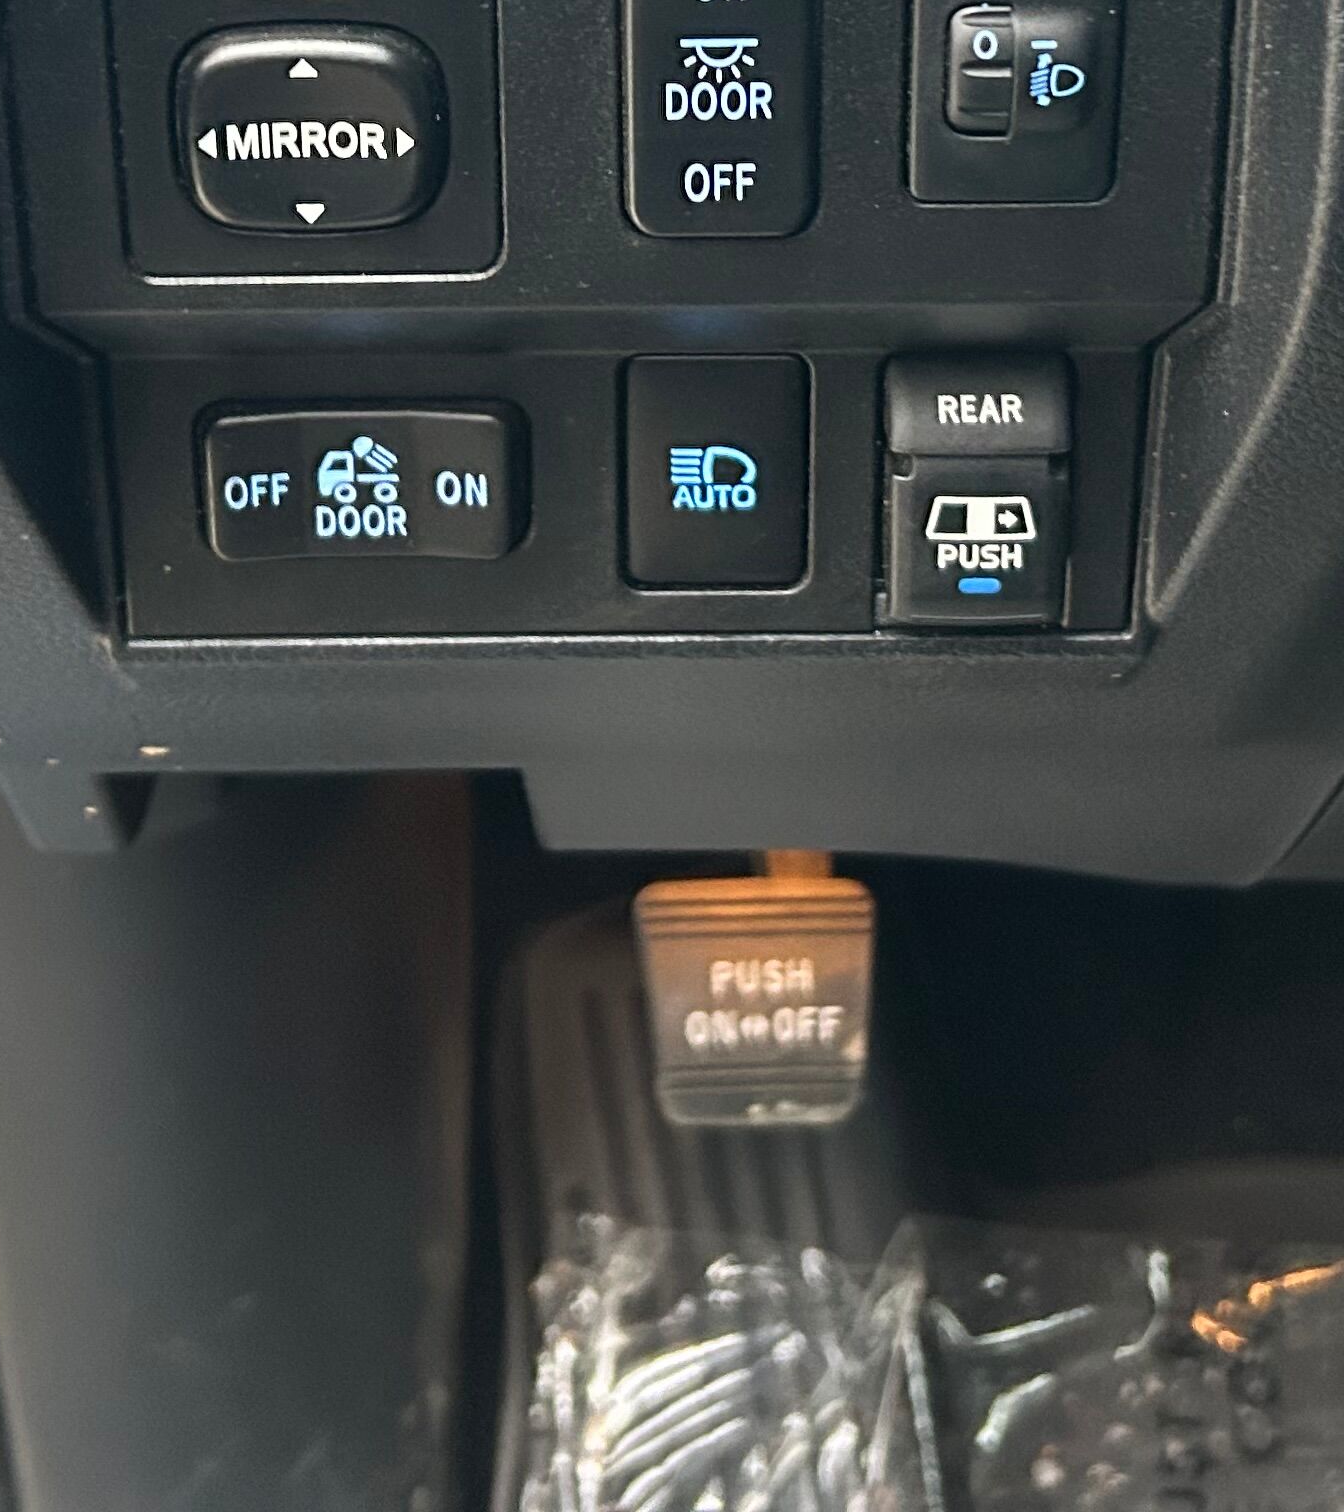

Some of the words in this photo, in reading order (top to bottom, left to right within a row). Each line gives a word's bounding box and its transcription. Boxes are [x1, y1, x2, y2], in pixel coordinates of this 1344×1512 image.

[972, 29, 999, 61] 0
[664, 82, 773, 122] DOOR
[224, 120, 388, 162] MIRROR
[683, 162, 757, 204] OFF
[936, 392, 1025, 427] REAR
[223, 471, 290, 510] OFF
[435, 470, 488, 508] ON
[671, 483, 758, 512] AUTO
[314, 505, 408, 538] DOOR
[936, 542, 1024, 571] PUSH
[709, 958, 815, 997] PUSH
[684, 1009, 739, 1050] ON
[772, 1005, 845, 1045] OFF
